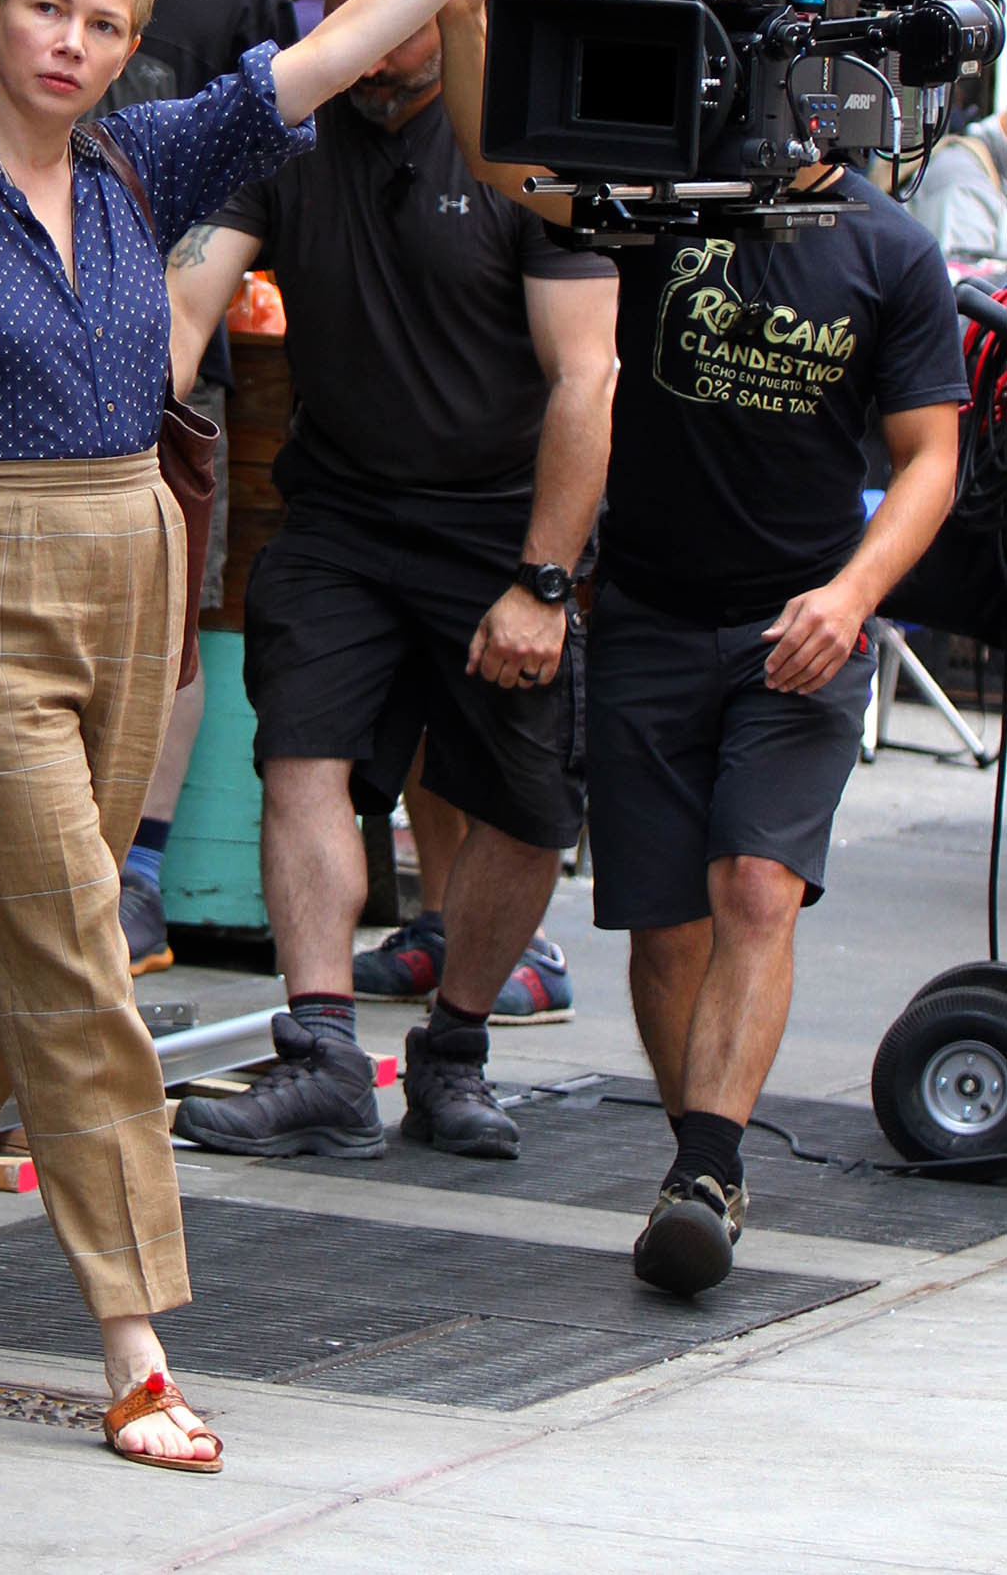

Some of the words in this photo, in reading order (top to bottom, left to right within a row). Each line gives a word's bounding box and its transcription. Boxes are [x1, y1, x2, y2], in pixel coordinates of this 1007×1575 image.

[695, 359, 737, 380] HECHO
[739, 371, 757, 385] EN
[759, 375, 802, 391] PUERTO
[696, 376, 733, 401] 0%
[736, 389, 784, 412] SALE
[789, 398, 820, 416] TAX
